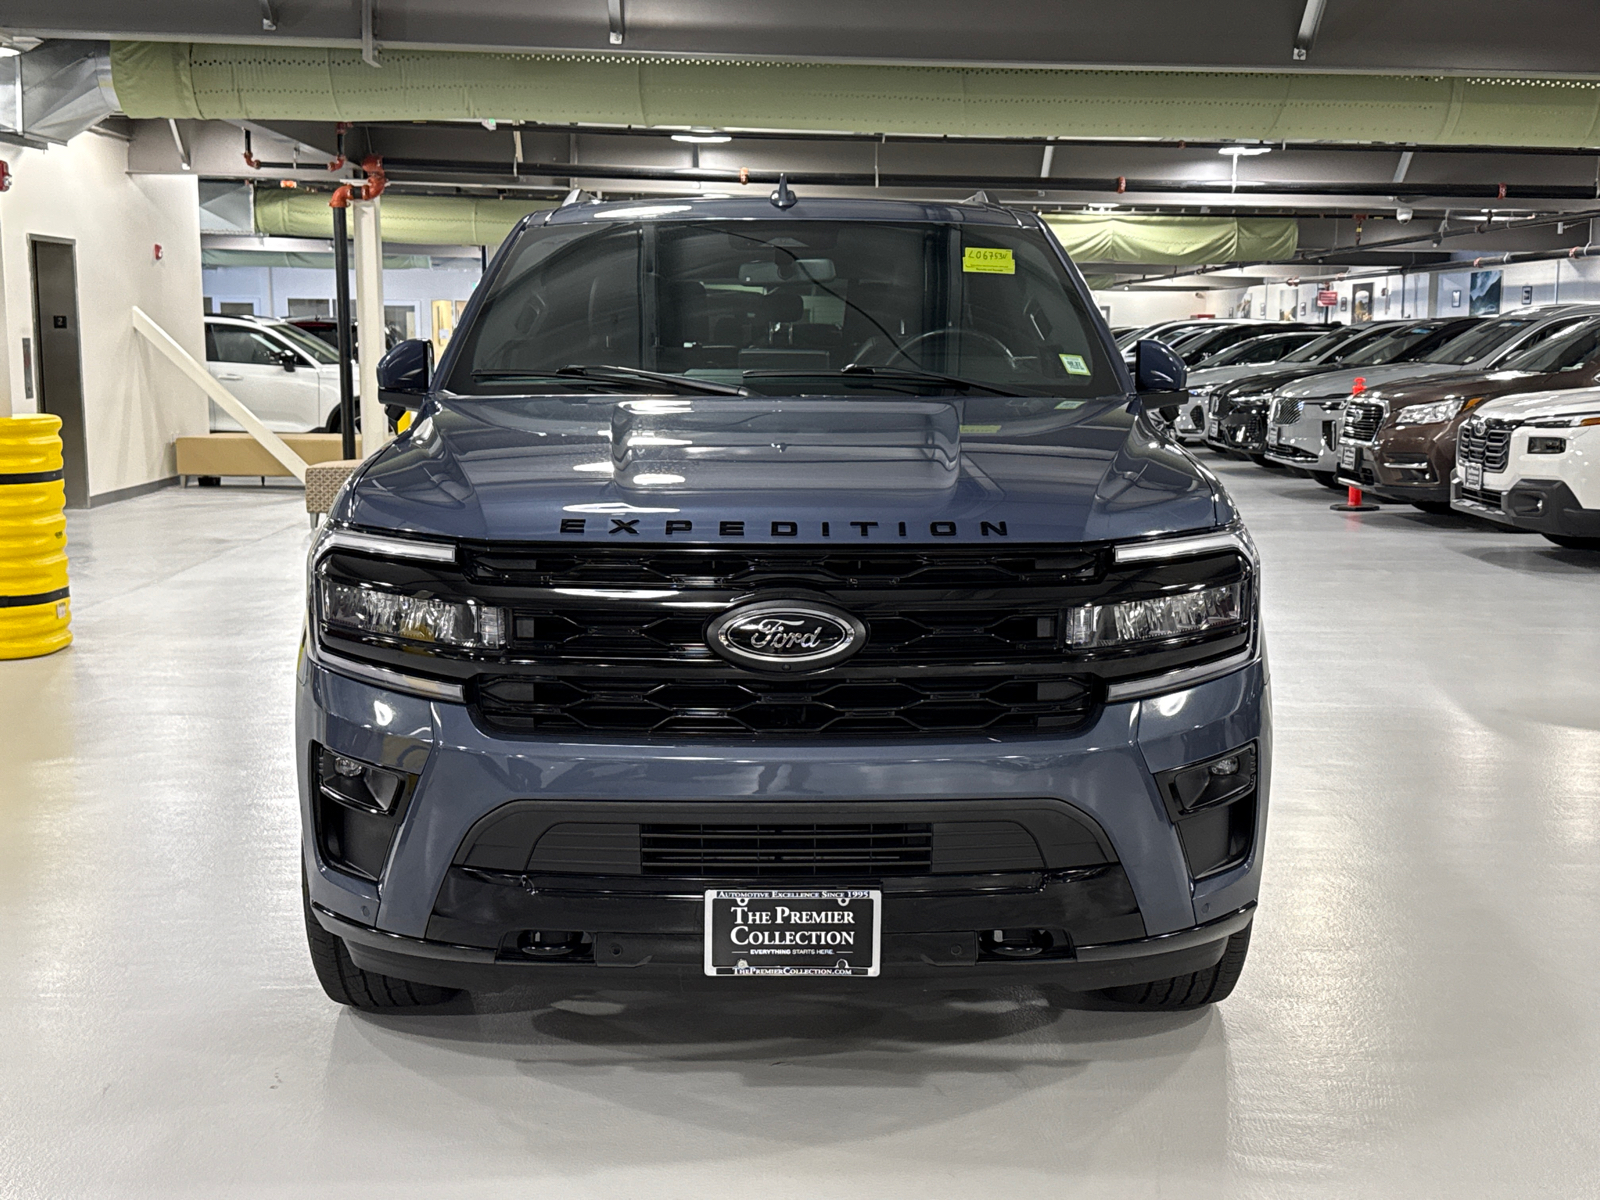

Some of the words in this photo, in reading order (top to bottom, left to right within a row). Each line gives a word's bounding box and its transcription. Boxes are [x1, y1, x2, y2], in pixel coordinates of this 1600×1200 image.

[560, 518, 1008, 537] EXPEDITION
[751, 618, 823, 649] Ford
[730, 906, 772, 924] THE
[775, 906, 855, 924] PREMIER
[730, 926, 855, 945] COLLECTION
